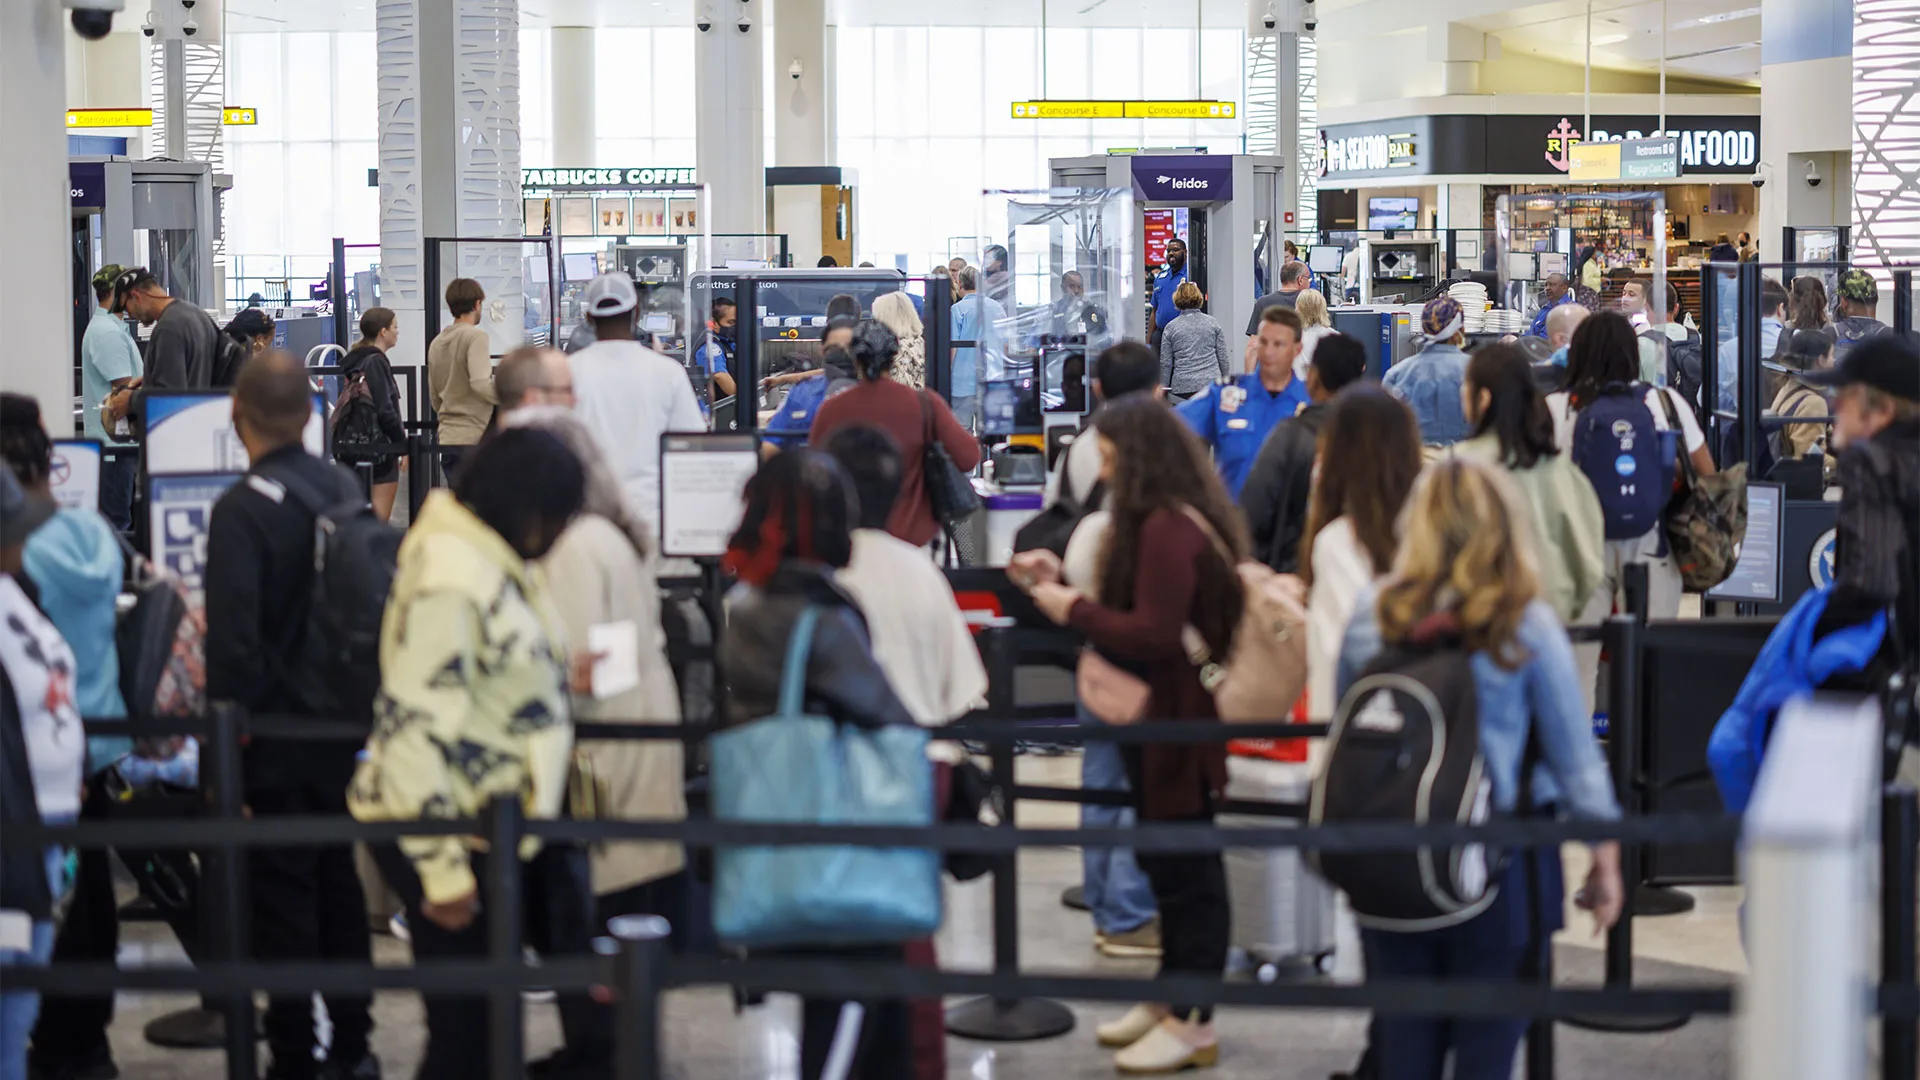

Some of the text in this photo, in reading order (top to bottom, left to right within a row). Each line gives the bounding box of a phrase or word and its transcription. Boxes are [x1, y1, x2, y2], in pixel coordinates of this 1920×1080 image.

[1039, 105, 1099, 115] Concourse E
[1147, 105, 1207, 115] Concourse D
[1389, 143, 1411, 157] BAR
[1636, 145, 1662, 156] Restrooms
[521, 169, 621, 185] TARBUCKS
[1172, 177, 1208, 189] leidos
